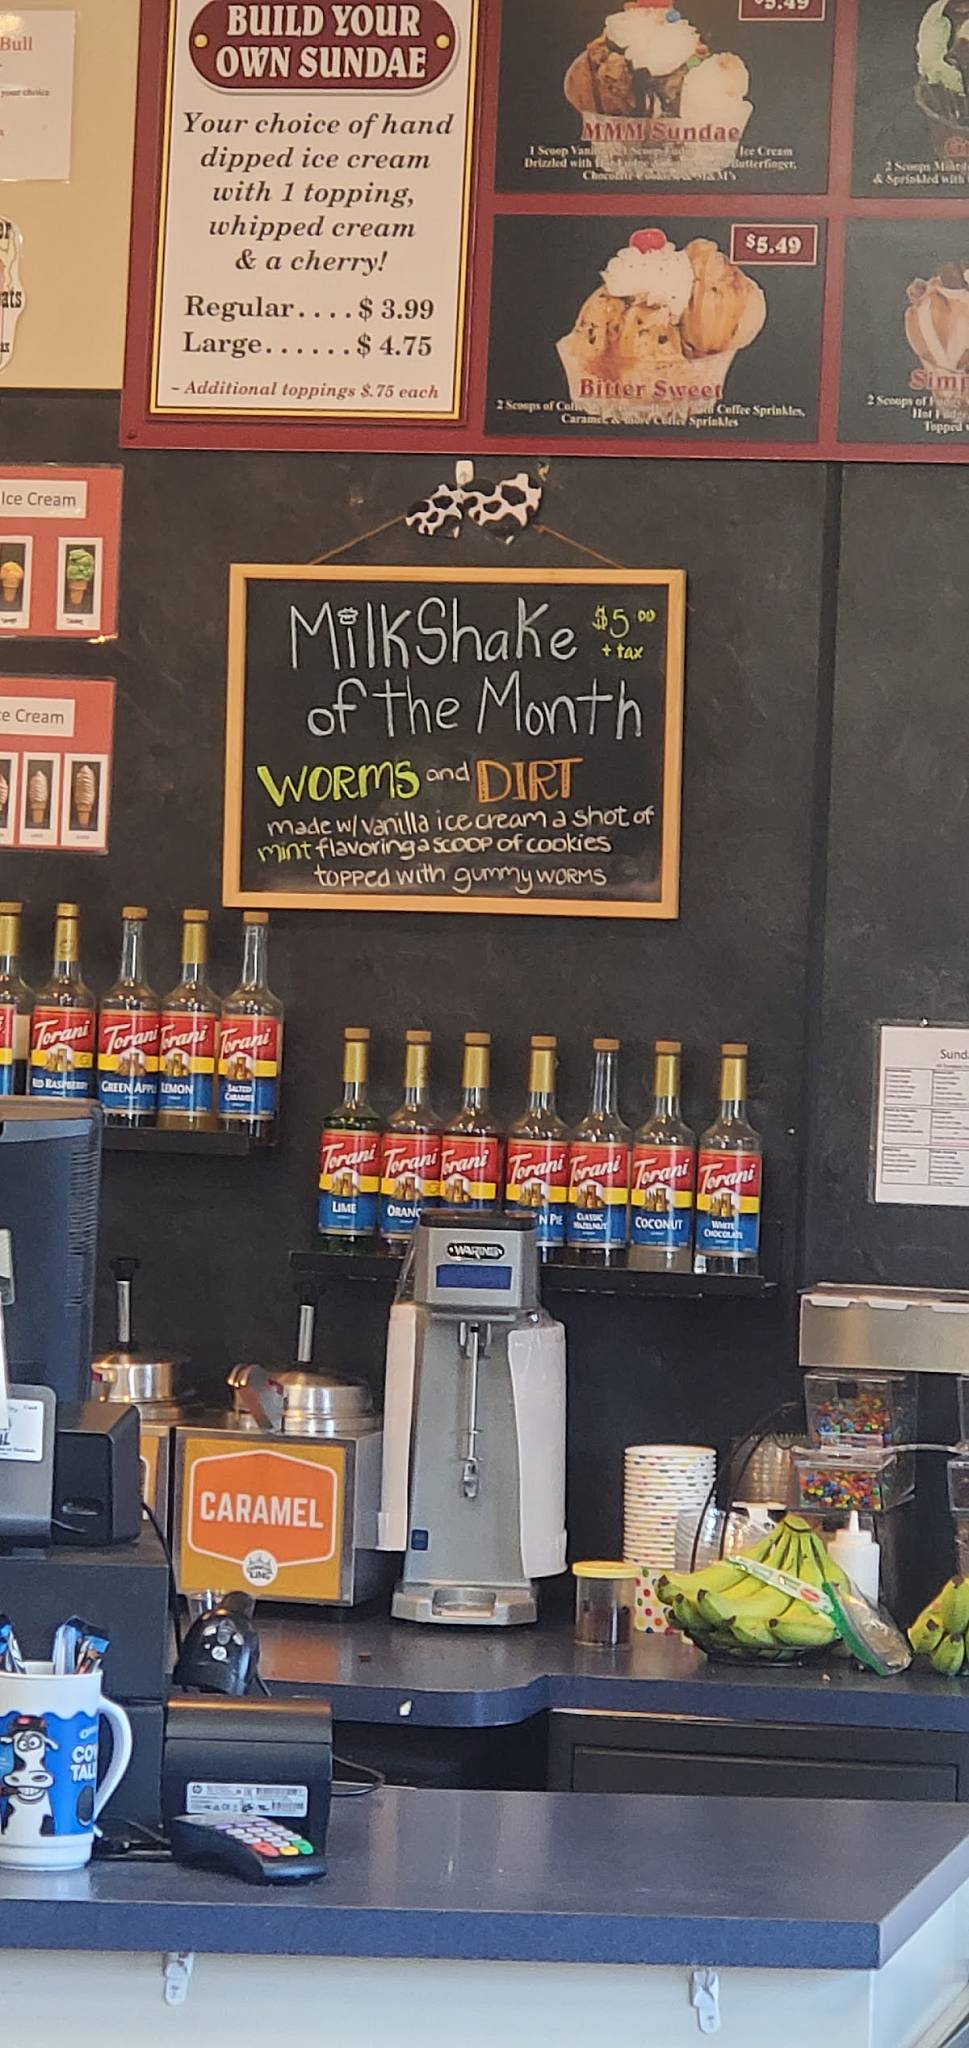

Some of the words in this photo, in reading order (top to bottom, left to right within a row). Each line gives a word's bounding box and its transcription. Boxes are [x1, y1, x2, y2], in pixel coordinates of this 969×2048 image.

[226, 4, 323, 37] BUILD
[327, 5, 422, 38] YOUR
[0, 36, 32, 51] Bull
[215, 46, 290, 78] OWN
[297, 47, 427, 79] SUNDAE
[183, 111, 248, 135] Your
[255, 112, 341, 136] choice
[347, 113, 380, 141] of
[382, 113, 455, 136] hand
[582, 122, 645, 142] MMM
[651, 123, 740, 142] Sundae
[200, 146, 295, 174] dipped
[300, 147, 339, 169] ice
[346, 153, 431, 170] cream
[524, 157, 567, 169] Drizzled
[569, 157, 593, 169] with
[537, 146, 569, 158] Scoop
[757, 146, 794, 157] Cream
[212, 181, 272, 202] with
[280, 182, 296, 203] 1
[303, 182, 416, 209] topping,
[208, 215, 324, 243] whipped
[331, 221, 417, 239] cream
[745, 233, 802, 256] $5.49
[234, 249, 257, 271] &
[265, 255, 283, 272] a
[290, 250, 389, 277] cherry!
[381, 298, 434, 320] 3.99
[379, 335, 433, 357] 4.75
[184, 381, 276, 398] Additional
[281, 384, 356, 401] toppings
[399, 385, 439, 401] each
[580, 378, 647, 400] Bitter
[652, 380, 723, 401] Sweet
[505, 401, 541, 413] Scoops
[543, 400, 555, 411] of
[716, 404, 751, 416] Coffee
[688, 416, 739, 429] Sprinkles
[2, 491, 23, 506] Ice
[27, 491, 76, 507] Cream
[616, 643, 644, 660] tax
[15, 708, 64, 725] Cream
[307, 677, 367, 737] of
[371, 675, 461, 738] the
[476, 670, 642, 740] Month
[256, 759, 421, 807] WORMS
[425, 761, 471, 784] and
[474, 757, 584, 804] DIRT
[266, 816, 332, 838] made
[435, 809, 472, 831] ice
[475, 809, 548, 831] cream
[552, 810, 568, 829] a
[571, 805, 631, 828] shot
[633, 805, 656, 827] of
[256, 841, 313, 863] mint
[315, 837, 416, 861] flavoring
[417, 838, 431, 852] a
[497, 832, 524, 851] of
[526, 832, 613, 854] cookies
[395, 863, 446, 886] with
[451, 865, 534, 895] gummy
[34, 1019, 91, 1051] Torani
[103, 1024, 160, 1056] Torani
[160, 1024, 209, 1053] Torani
[219, 1027, 273, 1061] Torani
[101, 1079, 132, 1094] GREEN
[160, 1081, 194, 1095] LEMON
[322, 1142, 377, 1175] Torani
[384, 1147, 439, 1179] Torani
[441, 1148, 490, 1177] Torani
[508, 1152, 566, 1185] Torani
[570, 1153, 622, 1188] Torani
[633, 1157, 690, 1192] Torani
[700, 1162, 757, 1195] Torani
[332, 1200, 358, 1214] LIME
[634, 1216, 683, 1231] COCONUT
[199, 1490, 325, 1530] CARAMEL
